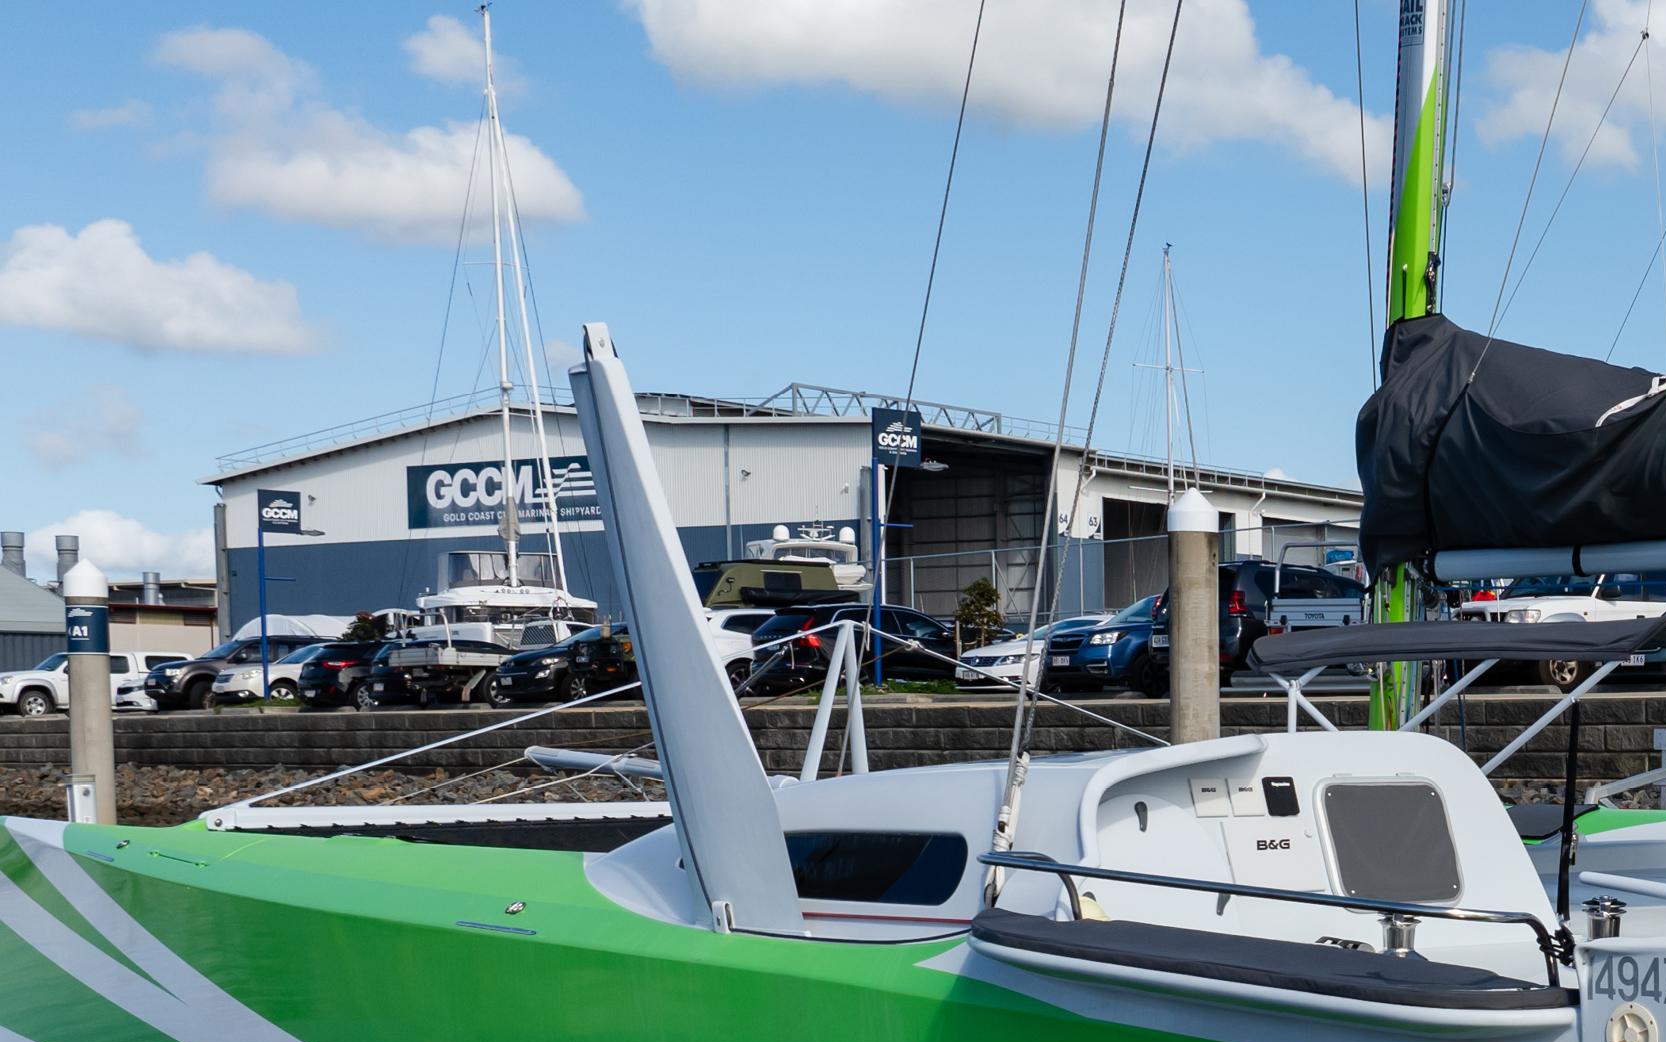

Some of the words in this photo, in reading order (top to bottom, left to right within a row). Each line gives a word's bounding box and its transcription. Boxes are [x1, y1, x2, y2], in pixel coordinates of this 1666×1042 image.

[426, 465, 533, 509] GCCM
[262, 507, 299, 520] GCCM
[443, 513, 466, 522] GOLD
[467, 511, 495, 521] COAST
[1058, 513, 1068, 525] 64
[1088, 516, 1098, 527] 63
[72, 625, 88, 637] A1
[1256, 839, 1291, 851] B&G
